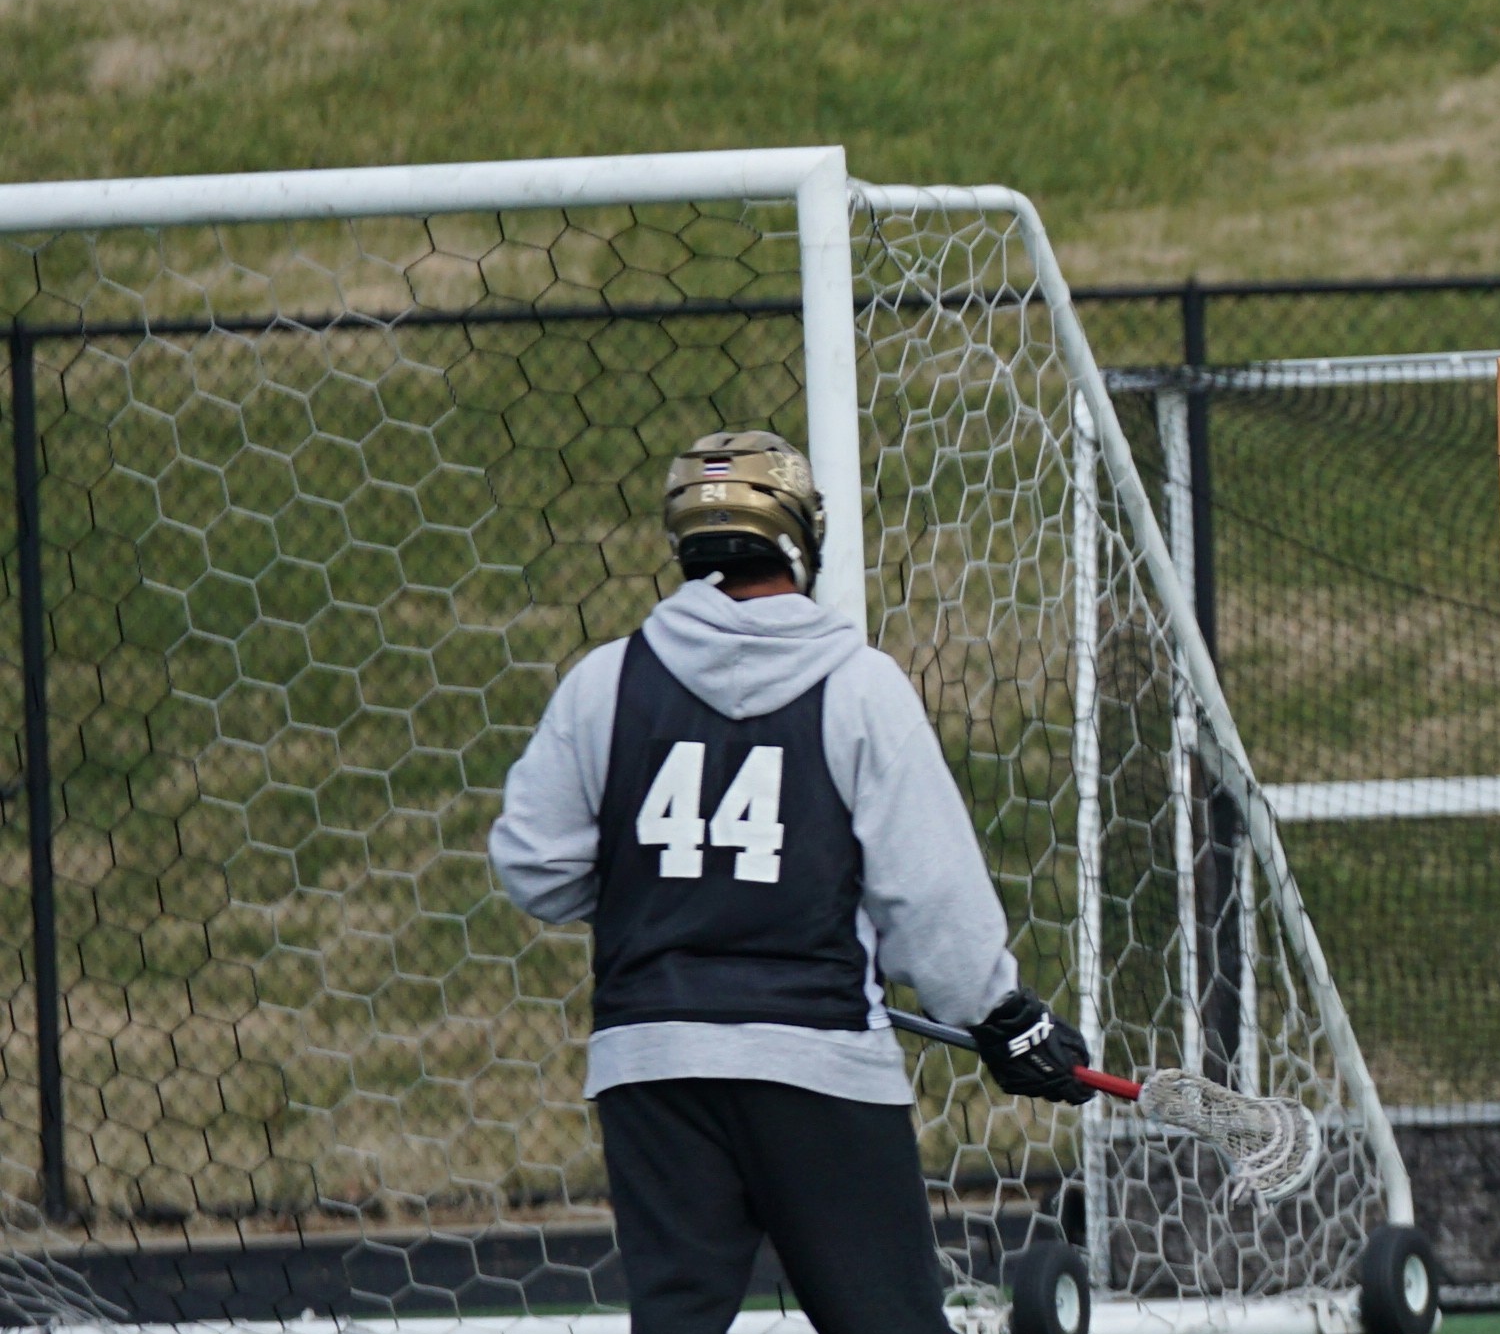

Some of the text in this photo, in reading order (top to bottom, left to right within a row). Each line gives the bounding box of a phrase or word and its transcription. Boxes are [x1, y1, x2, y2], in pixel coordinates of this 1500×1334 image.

[701, 484, 727, 503] 24
[637, 742, 784, 884] 44
[1008, 1012, 1055, 1059] STX
